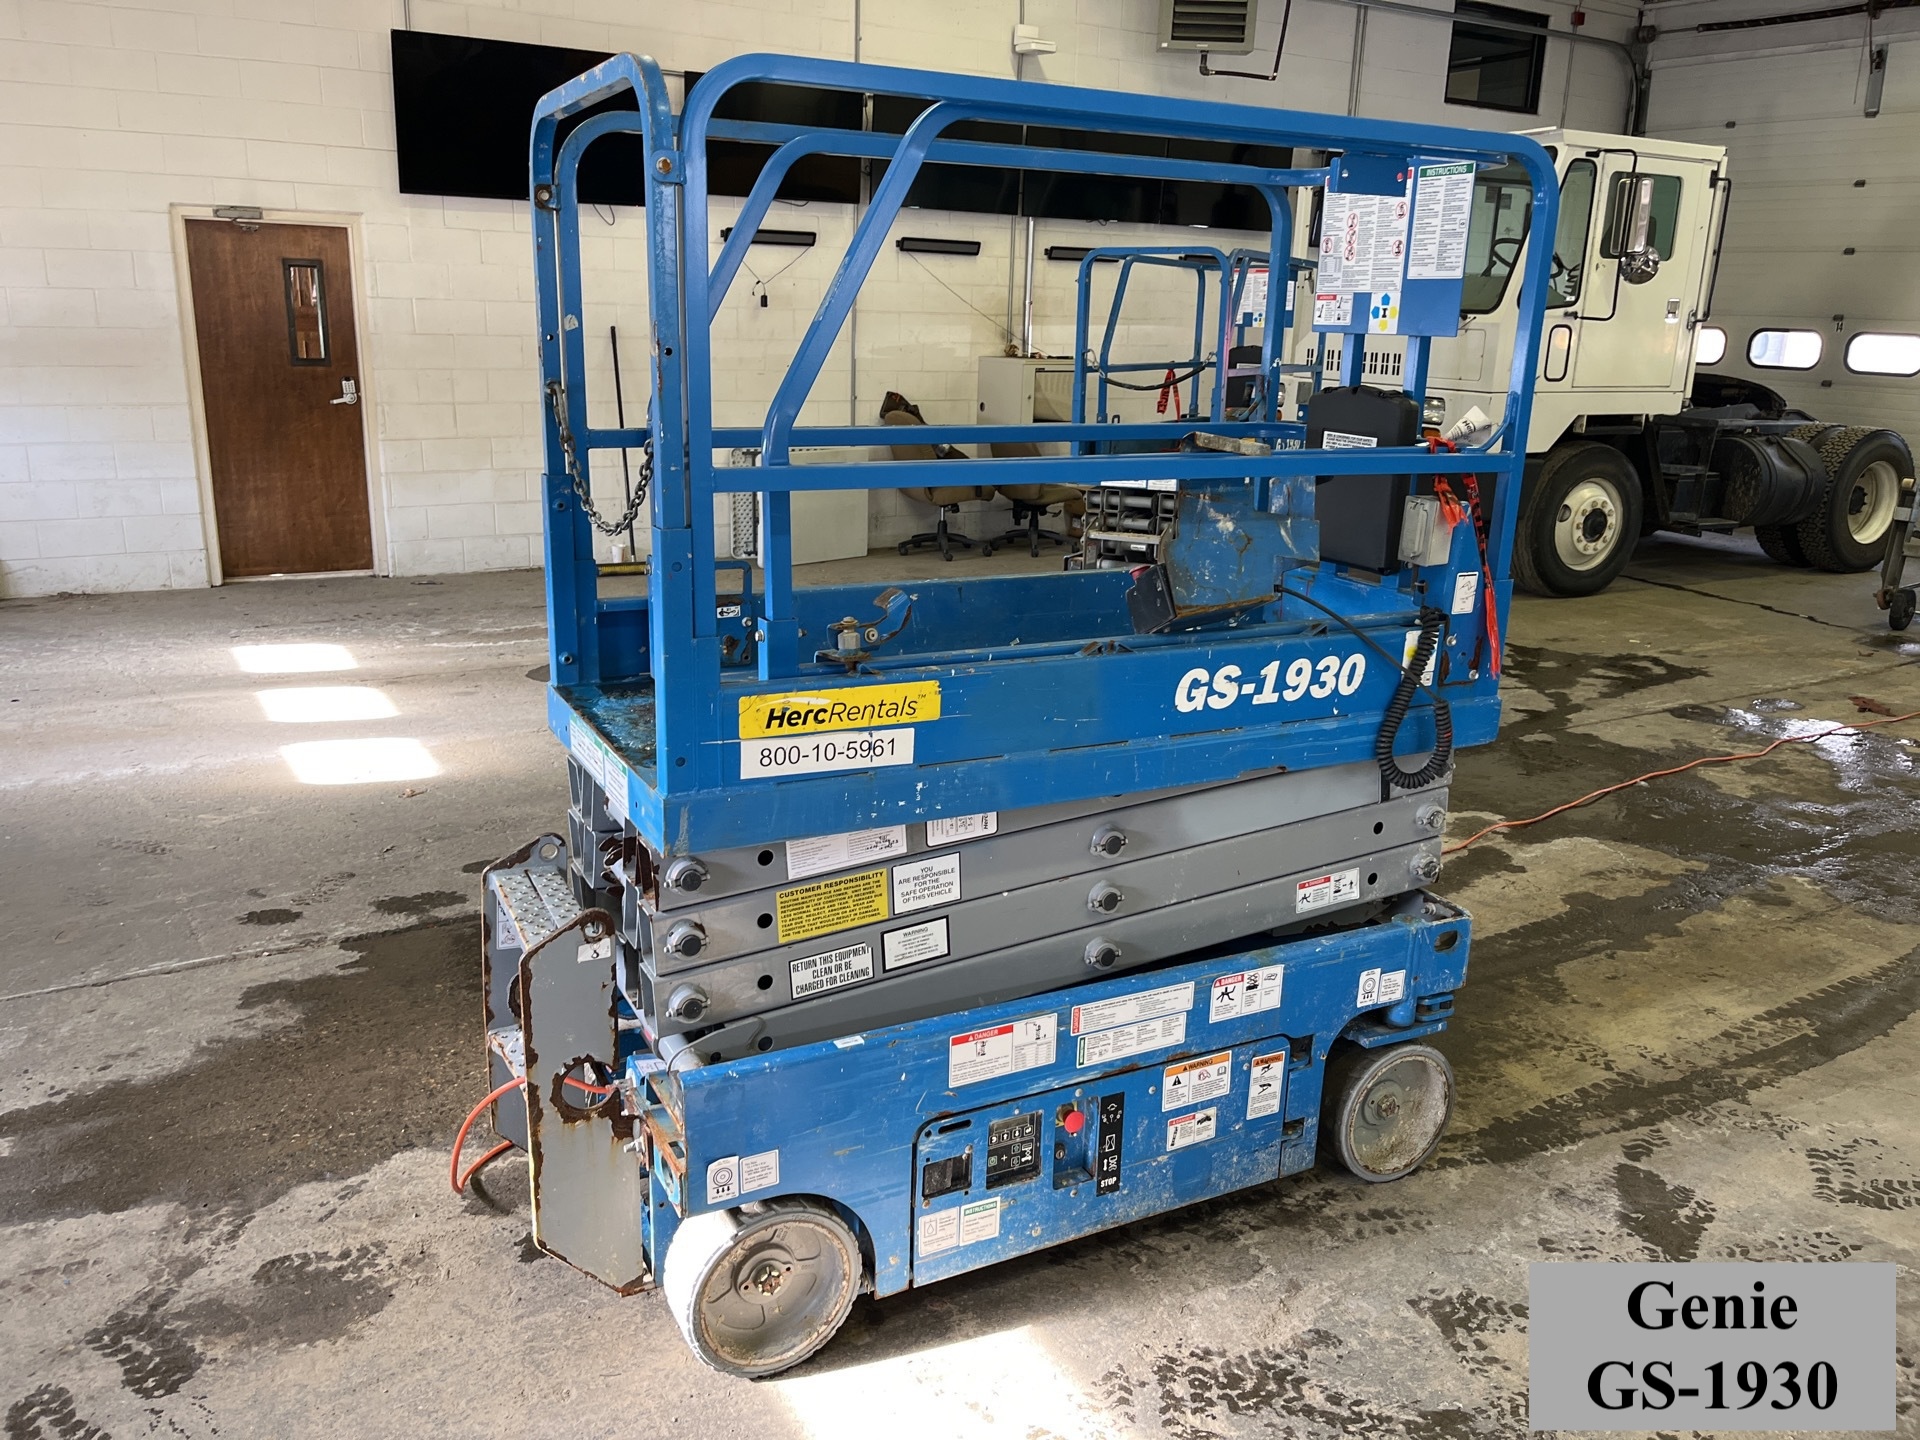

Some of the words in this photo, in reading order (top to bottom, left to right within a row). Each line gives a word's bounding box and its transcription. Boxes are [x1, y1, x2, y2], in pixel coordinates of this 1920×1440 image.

[1426, 165, 1467, 176] INSTRUCTIONS
[1174, 653, 1366, 713] GS-1930
[765, 696, 918, 730] HercRentals
[760, 738, 896, 767] 800-10-5961
[898, 876, 912, 885] ARE
[912, 868, 956, 882] RESPONSIBLE
[779, 885, 821, 899] CUSTOMER
[824, 871, 883, 889] RESPONSIBILITY
[900, 889, 917, 898] SAFE
[918, 881, 954, 894] OPERATION
[914, 880, 927, 888] FOR
[800, 890, 831, 900] MAINTENANCE
[912, 892, 926, 902] THIS
[926, 888, 952, 899] VEHICLE
[780, 898, 814, 909] RESPONSIBILITY
[780, 906, 803, 914] RETURNED
[822, 897, 845, 905] CONDITION
[828, 905, 850, 913] ABNORMAL
[812, 912, 839, 921] APPLICATION
[782, 924, 805, 932] CONDITION
[814, 920, 848, 930] RESPONSIBILITY
[903, 926, 928, 938] WARNING
[792, 958, 817, 973] RETURN
[818, 954, 834, 966] THIS
[834, 945, 870, 962] EQUIPMENT
[812, 966, 832, 979] CLEAN
[834, 963, 842, 974] OR
[844, 960, 852, 970] BE
[796, 979, 824, 994] CHARGED
[826, 976, 838, 987] FOR
[839, 966, 870, 984] CLEANING
[1220, 975, 1242, 985] DANGER
[974, 1028, 998, 1040] DANGER
[1188, 1058, 1214, 1070] WARNING
[1100, 1176, 1116, 1188] STOP
[966, 1202, 996, 1214] INSTRUCTIONS
